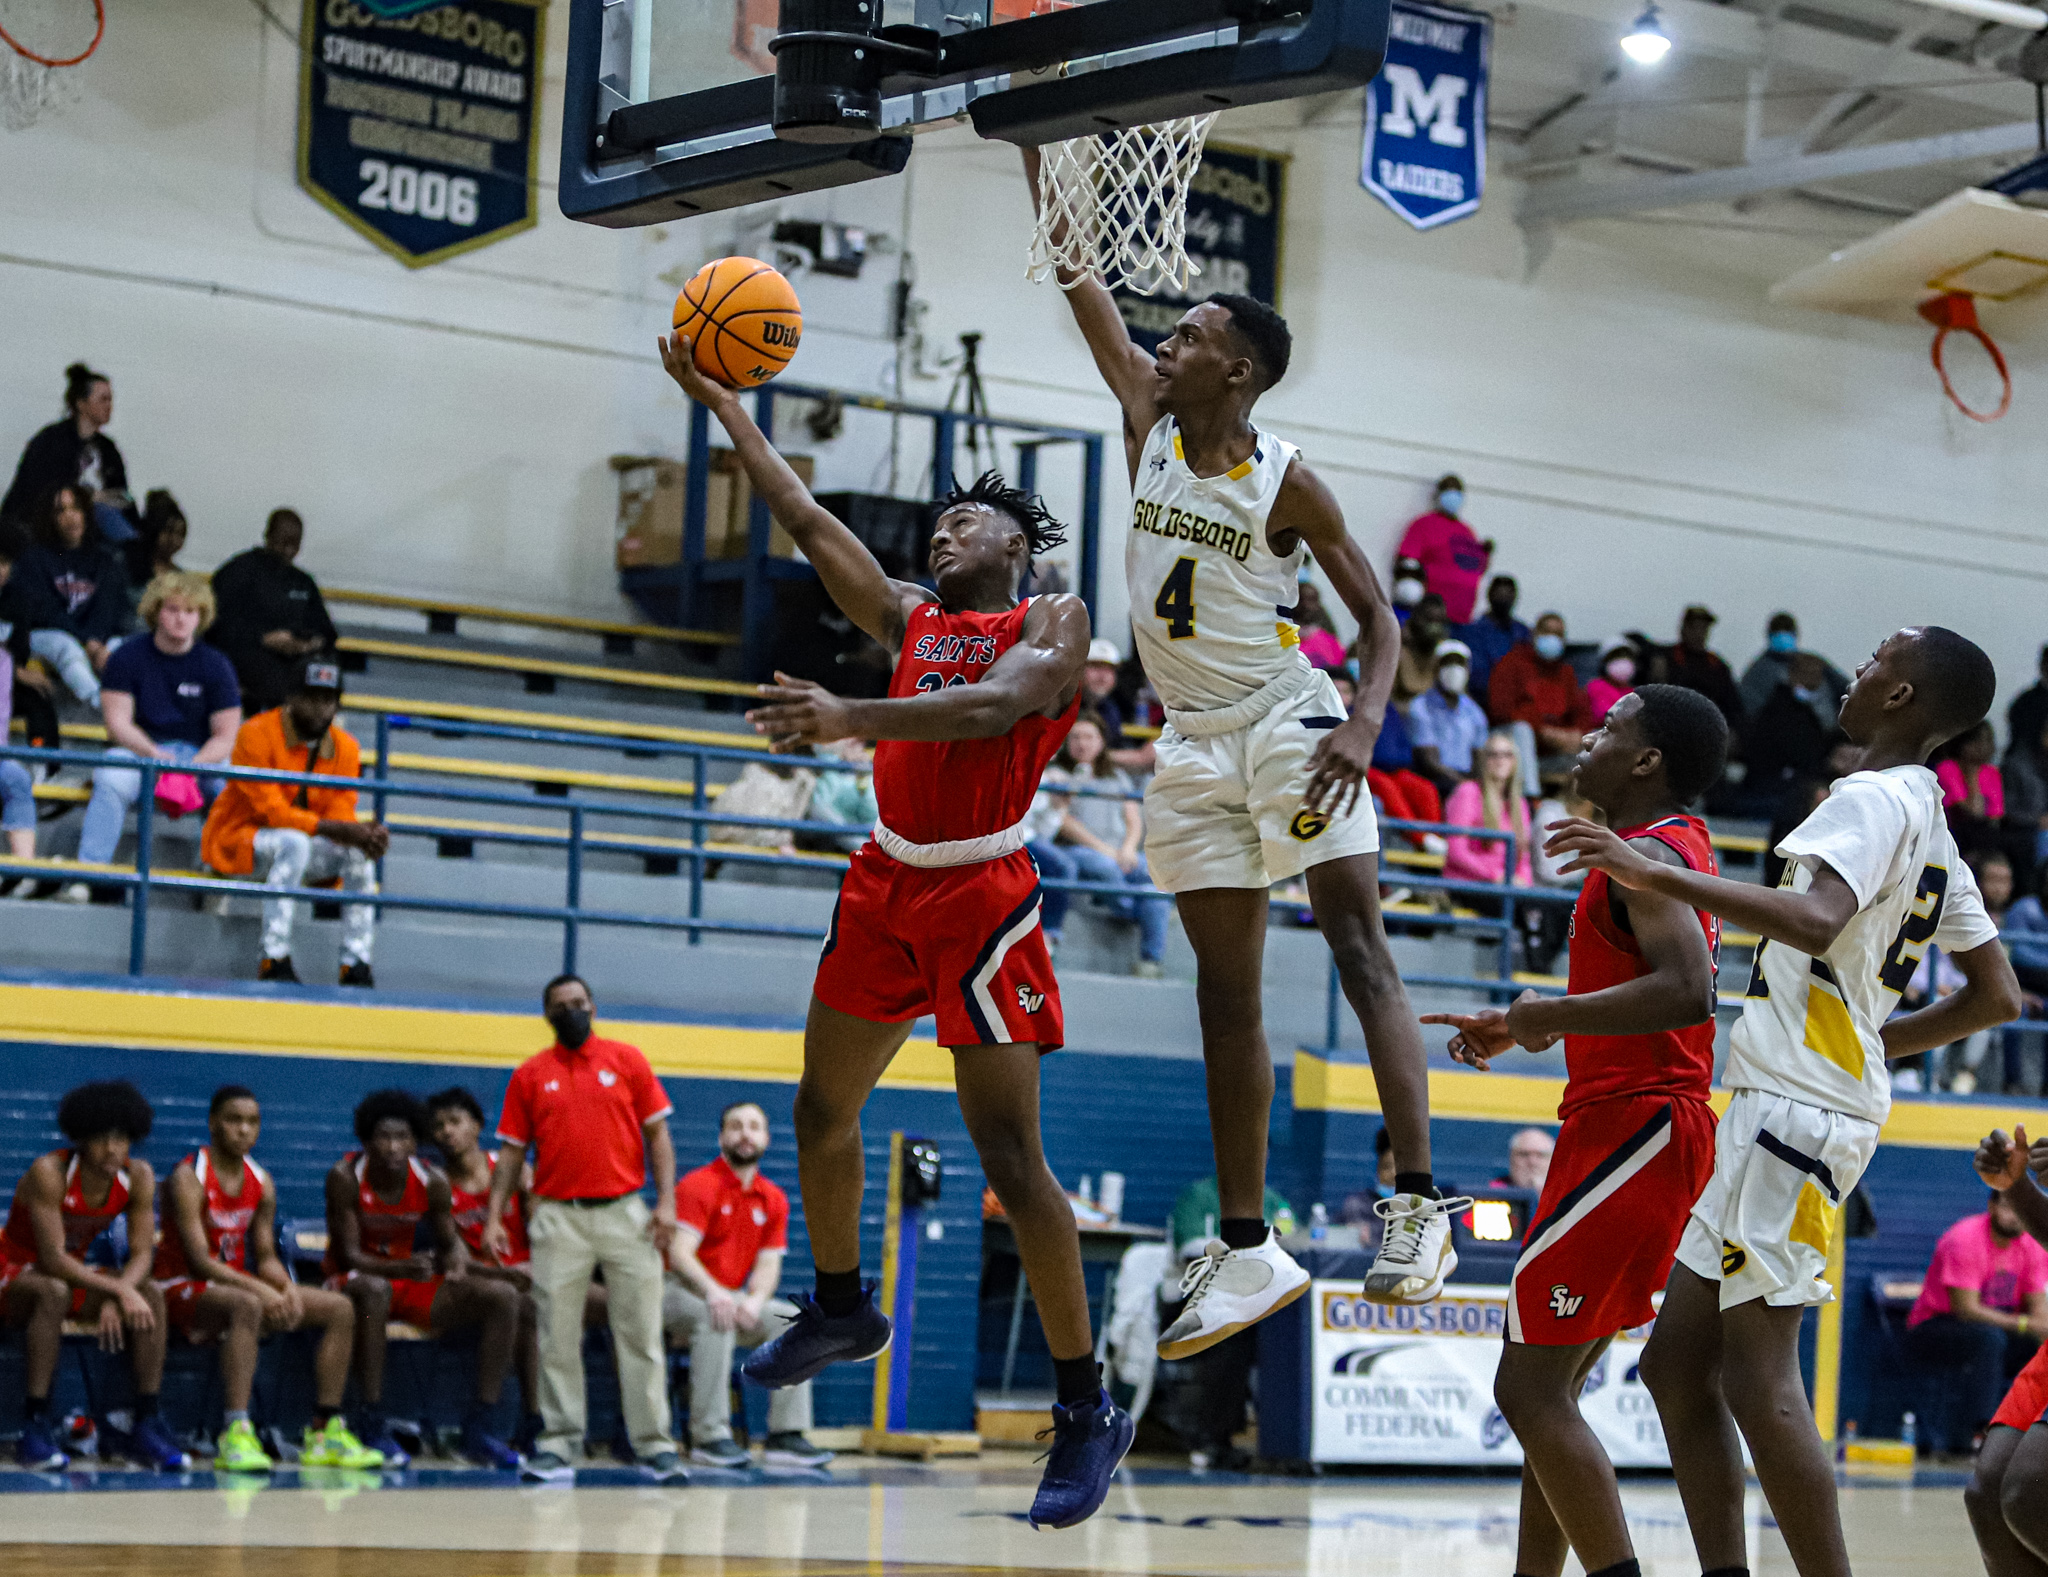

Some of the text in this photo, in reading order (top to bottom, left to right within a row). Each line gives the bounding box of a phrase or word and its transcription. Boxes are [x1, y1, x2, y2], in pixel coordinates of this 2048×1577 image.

[325, 0, 526, 67] GOSBORO
[1381, 62, 1469, 148] M
[358, 159, 479, 226] 2006
[1133, 499, 1251, 562] GOLDSBORO
[1154, 555, 1198, 642] 4
[914, 634, 997, 665] SAINTS
[1017, 984, 1045, 1014] SW
[1328, 1298, 1504, 1334] GOLDSBOR
[1549, 1287, 1584, 1318] SW
[1345, 1411, 1462, 1438] FEDERAL
